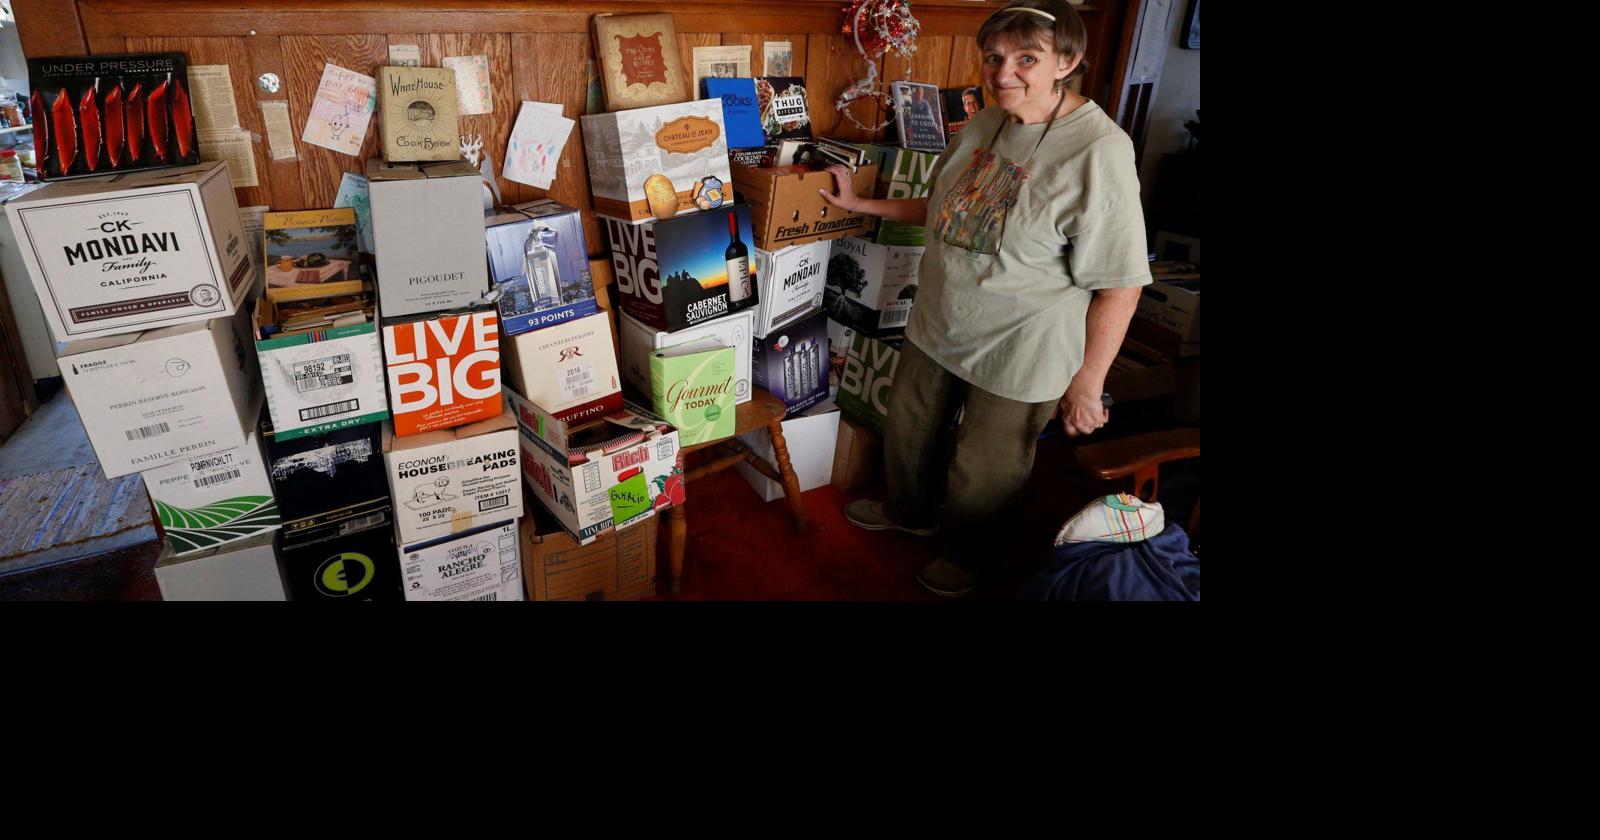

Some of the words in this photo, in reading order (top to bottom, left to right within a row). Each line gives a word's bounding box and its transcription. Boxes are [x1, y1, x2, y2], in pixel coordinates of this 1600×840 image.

[42, 62, 95, 74] UNDER
[100, 58, 174, 71] PRESSURE
[774, 98, 802, 108] THUG
[776, 107, 804, 116] KITCHEN
[663, 132, 690, 142] CHATEAU
[698, 128, 713, 136] JEAN
[892, 150, 940, 184] LIV
[100, 219, 132, 233] CK
[776, 223, 809, 238] Fresh
[812, 216, 865, 232] Tomatoes
[606, 217, 658, 260] LIVE
[63, 231, 180, 266] MONDAVI
[102, 256, 157, 274] Family
[798, 256, 810, 268] CK
[100, 273, 168, 288] CALIFORNIA
[409, 272, 464, 285] PIGOUDET
[612, 250, 664, 304] BIG
[783, 262, 821, 291] MONDAVI
[80, 309, 108, 317] FAMILY
[112, 304, 138, 313] OWNED
[148, 297, 186, 308] OPERATED
[687, 293, 726, 312] CABERNET
[528, 318, 540, 326] 93
[541, 309, 575, 323] POINTS
[686, 302, 728, 322] SAUVIGNON
[383, 311, 500, 366] LIVE
[538, 339, 564, 350] CHIANTI
[564, 331, 594, 342] SUPERIORE
[80, 360, 108, 369] FRAGILE
[848, 331, 900, 380] LIV
[303, 362, 325, 374] 98192
[388, 350, 502, 414] BIG
[110, 400, 137, 410] PERRIN
[138, 394, 168, 405] RESERVE
[666, 376, 732, 412] Gourmet
[685, 398, 716, 410] TODAY
[304, 424, 338, 434] EXTRA
[341, 418, 361, 426] DRY
[130, 448, 177, 465] FAMILLE
[180, 440, 216, 452] PERRIN
[612, 444, 650, 472] Rich
[398, 449, 516, 480] HOUSEBREAKING
[482, 458, 517, 472] PADS
[584, 525, 598, 537] VINE
[448, 544, 473, 554] TEQUILA
[438, 554, 486, 573] RANCHO
[441, 561, 484, 579] ALEGRE
